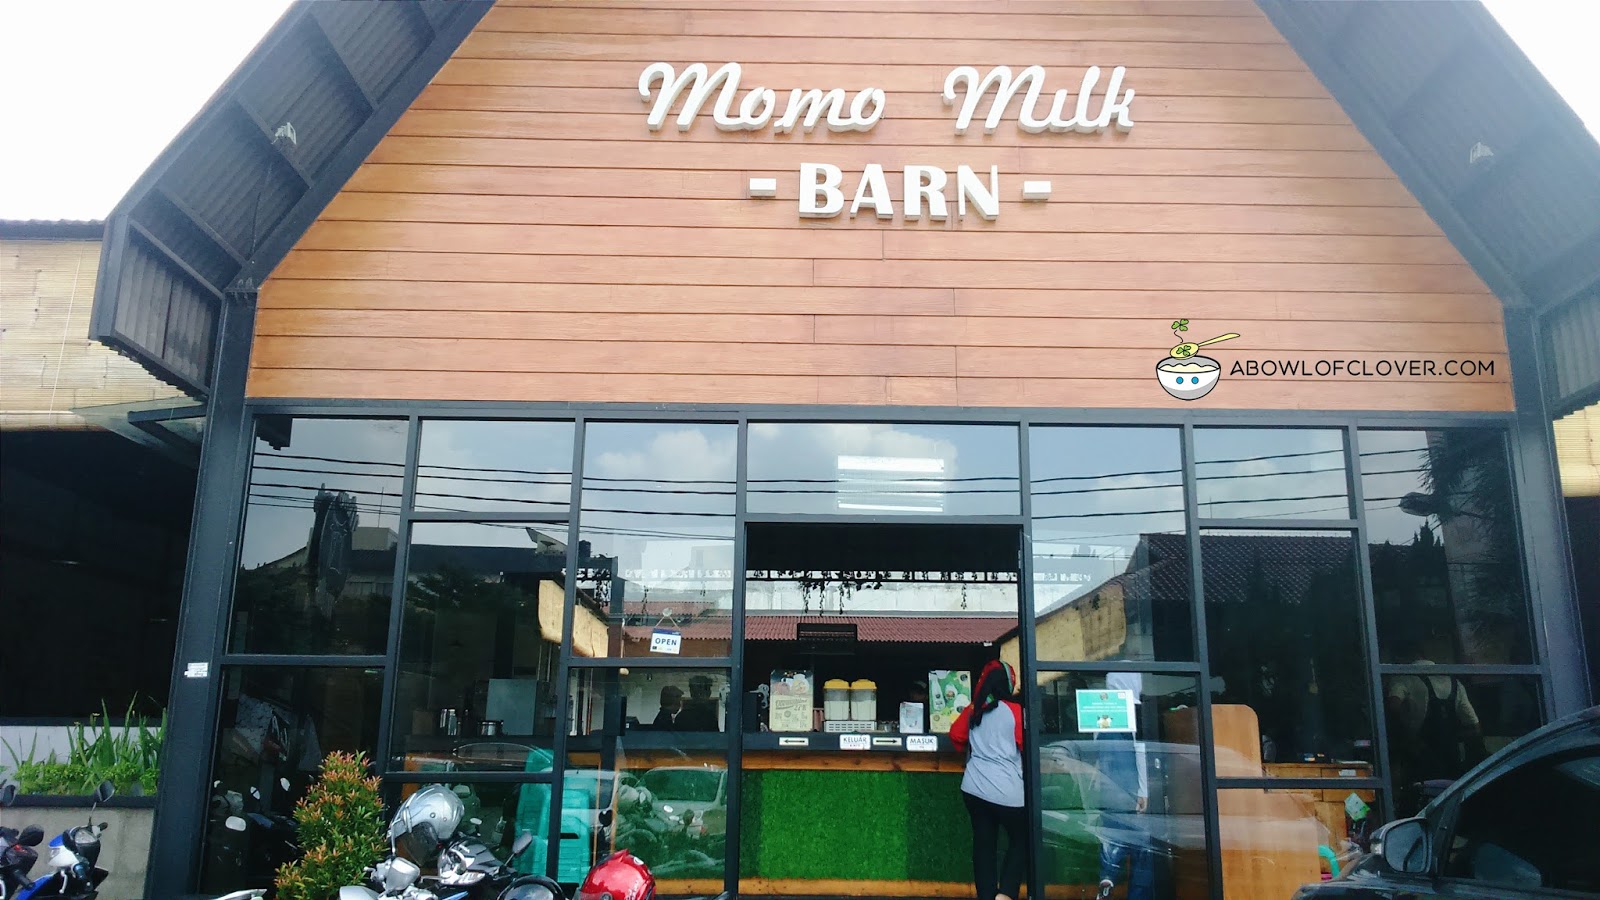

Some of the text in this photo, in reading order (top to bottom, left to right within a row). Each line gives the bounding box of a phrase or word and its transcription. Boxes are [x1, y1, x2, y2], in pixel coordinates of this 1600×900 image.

[638, 62, 1135, 135] Momo Milk
[799, 162, 999, 221] BARN
[655, 637, 677, 646] OPEN
